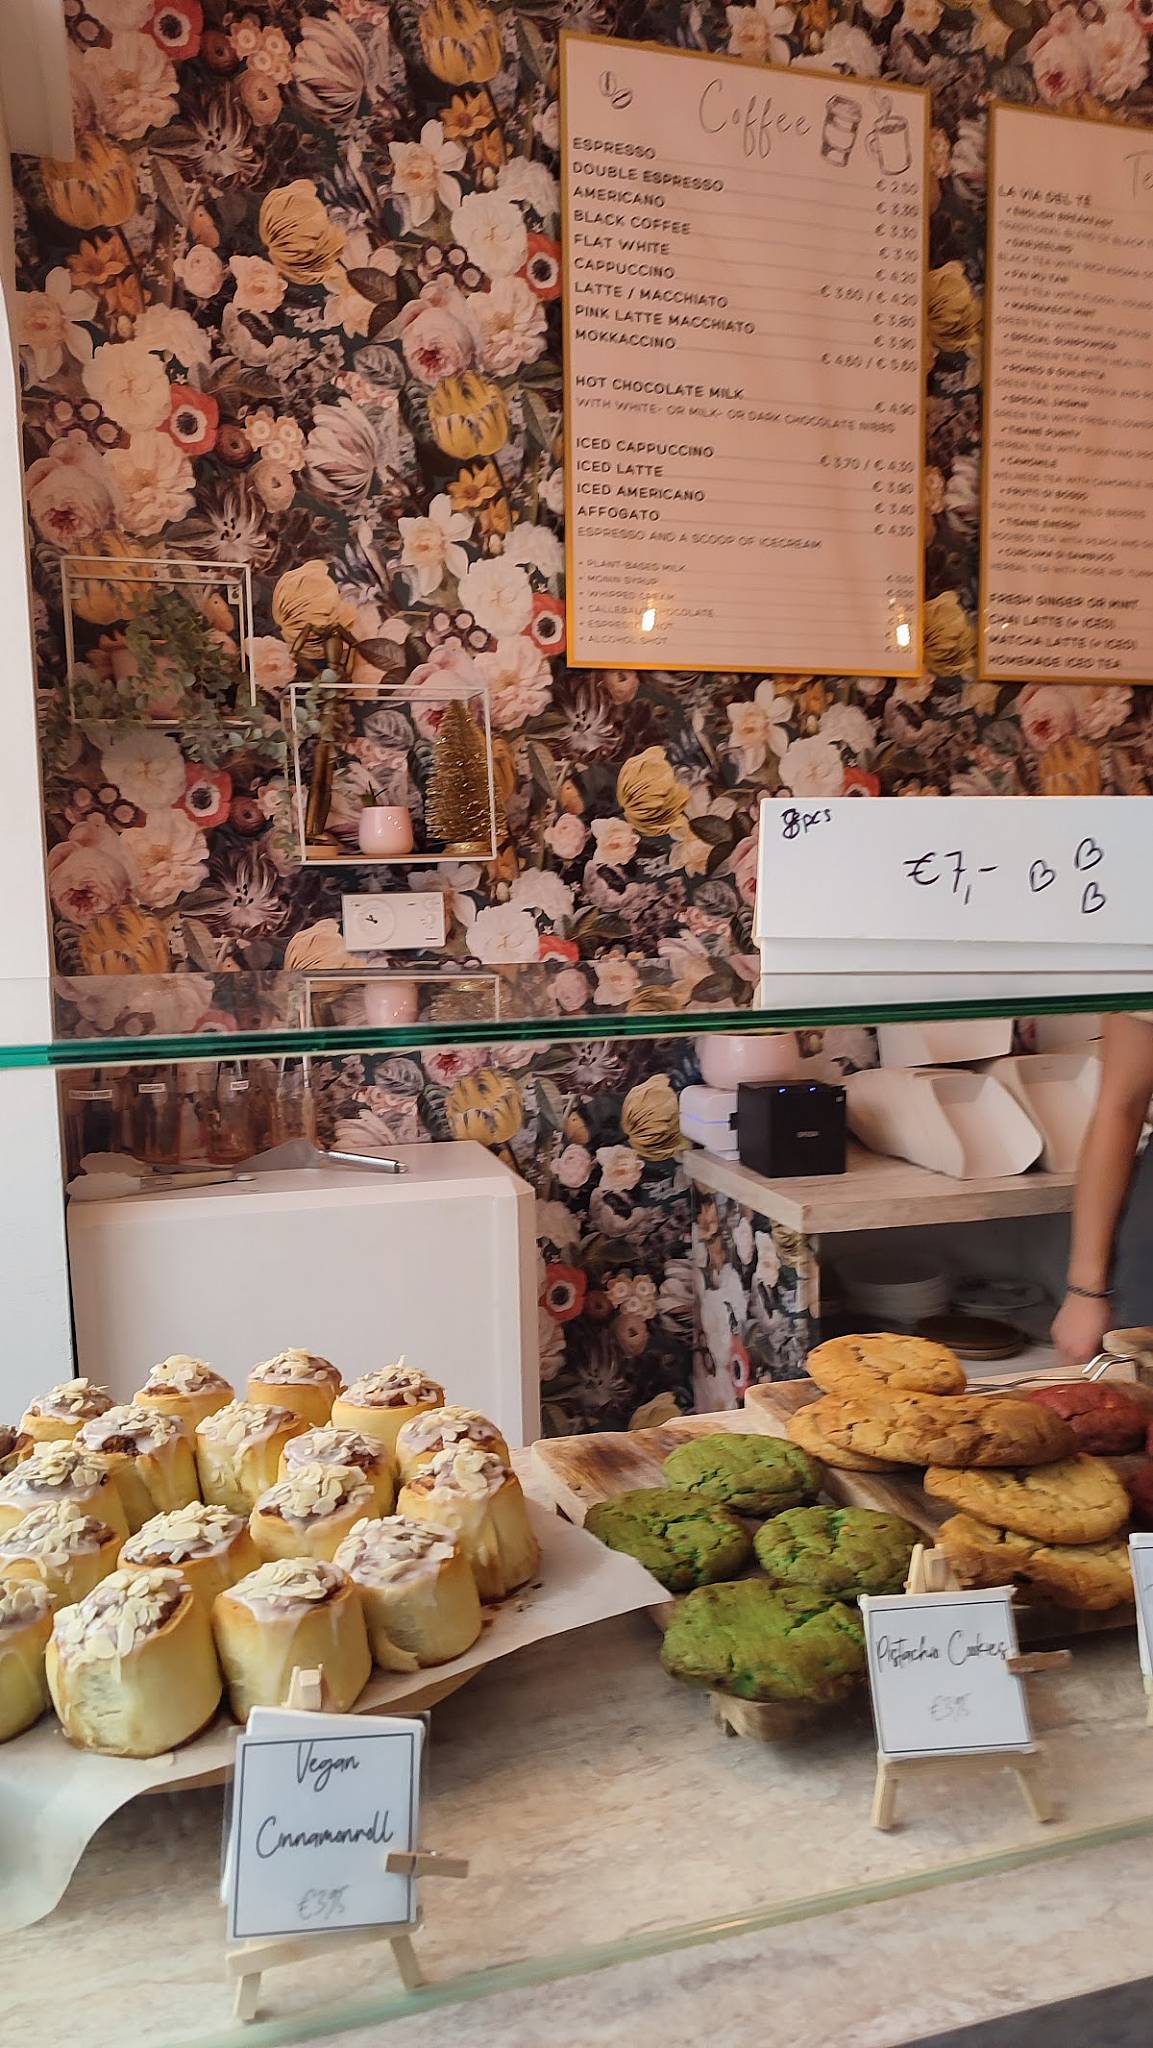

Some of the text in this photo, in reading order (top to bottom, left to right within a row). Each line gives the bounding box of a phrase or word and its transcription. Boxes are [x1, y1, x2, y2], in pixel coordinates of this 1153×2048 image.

[698, 78, 812, 159] Coffee
[573, 137, 656, 160] ESPRESSO
[876, 179, 886, 192] €
[573, 161, 638, 180] DOUBLE
[643, 170, 724, 192] ESPRESSO
[876, 202, 886, 215] €
[573, 186, 665, 208] AMERICANO
[875, 224, 886, 236] €
[574, 209, 625, 226] BLACK
[630, 215, 691, 235] COFFEE
[879, 246, 890, 260] €
[574, 233, 612, 248] FLAT
[619, 239, 670, 255] WHITE
[876, 268, 886, 282] €
[574, 257, 675, 279] CAPPUCCINO
[820, 285, 832, 298] €
[876, 291, 888, 304] €
[575, 281, 622, 298] LATTE
[640, 289, 728, 308] MACCHIATO
[873, 313, 885, 326] €
[576, 304, 609, 320] PINK
[615, 309, 663, 326] LATTE
[668, 314, 755, 334] MACCHIATO
[874, 335, 885, 348] €
[576, 328, 676, 349] MOKKACCINO
[822, 353, 832, 366] €
[876, 358, 888, 370] €
[576, 375, 606, 388] HOT
[612, 378, 704, 398] CHOCOLATE
[709, 386, 745, 400] MILK
[874, 401, 884, 414] €
[578, 398, 610, 409] WITH
[576, 438, 611, 450] ICED
[616, 440, 714, 458] CAPPUCCINO
[819, 454, 830, 468] €
[874, 458, 884, 472] €
[576, 460, 611, 474] ICED
[616, 463, 664, 478] LATTE
[872, 480, 882, 493] €
[576, 483, 611, 496] ICED
[616, 486, 706, 502] AMERICANO
[874, 502, 884, 514] €
[577, 505, 660, 522] AFFOGATO
[873, 523, 884, 536] €
[578, 526, 646, 541] ESPRESSO
[650, 532, 676, 543] AND
[678, 532, 690, 543] A
[692, 534, 736, 546] SCOOP
[738, 536, 755, 547] OF
[876, 1635, 939, 1672] Pistachio
[296, 1741, 360, 1792] Vegan
